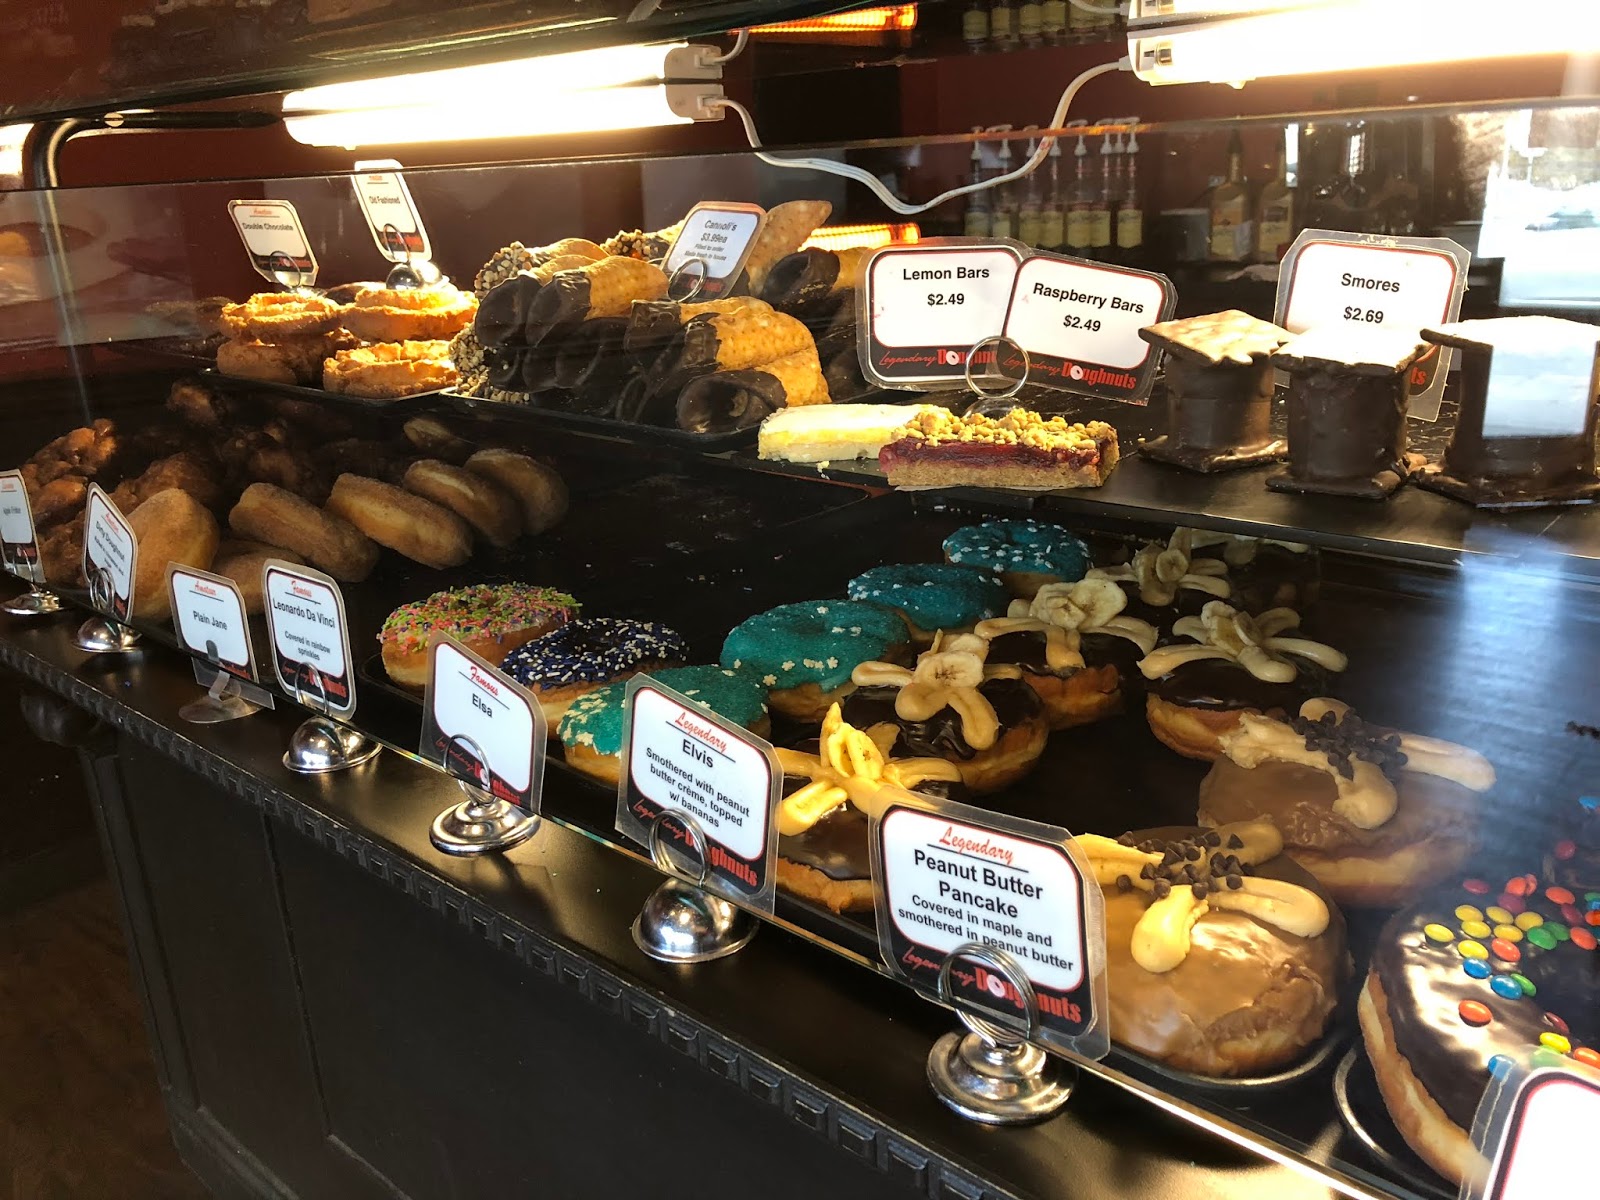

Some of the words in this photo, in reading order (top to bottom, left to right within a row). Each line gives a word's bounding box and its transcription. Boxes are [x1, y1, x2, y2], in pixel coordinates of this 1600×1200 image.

[242, 222, 263, 230] Double
[264, 222, 294, 231] Chocolate
[701, 232, 728, 244] $3.99ea
[705, 219, 737, 231] Cannoli's
[903, 267, 952, 280] Lemon
[957, 267, 990, 279] Bars
[1341, 272, 1400, 292] Smores
[927, 293, 965, 306] $2.49
[1033, 282, 1107, 309] Raspberry
[1110, 296, 1144, 314] Bars
[1063, 314, 1101, 333] $2.49
[1343, 306, 1384, 324] $2.69
[879, 350, 937, 369] Legendary
[1061, 361, 1137, 389] Doughnuts
[193, 610, 210, 625] Plain
[211, 617, 228, 631] Jane
[273, 597, 305, 618] Leonardo
[306, 608, 316, 622] Da
[317, 612, 335, 628] Vinci
[284, 630, 304, 645] Covered
[306, 637, 311, 646] in
[311, 641, 331, 654] rainbow
[298, 647, 320, 661] sprinkles
[470, 665, 499, 697] Famous
[472, 693, 493, 718] Elsa
[674, 711, 727, 754] Legendary
[683, 738, 714, 768] Elvis
[646, 747, 693, 780] Smothered
[695, 776, 714, 795] with
[717, 790, 750, 817] peanut
[650, 763, 675, 787] butter
[677, 781, 708, 808] crème,
[710, 800, 743, 827] topped
[669, 790, 680, 803] w/
[681, 796, 719, 828] bananas
[684, 827, 757, 887] Dghnuts
[938, 826, 1015, 865] Legendary
[914, 849, 978, 882] Peanut
[982, 867, 1043, 899] Butter
[939, 880, 1018, 918] Pancake
[912, 894, 963, 920] Covered
[967, 910, 979, 925] in
[983, 918, 1023, 943] maple
[1027, 931, 1053, 947] and
[898, 907, 963, 937] smothered
[967, 927, 978, 942] in
[982, 934, 1028, 959] peanut
[1032, 950, 1074, 972] butter
[974, 966, 1082, 1024] Dougnuts
